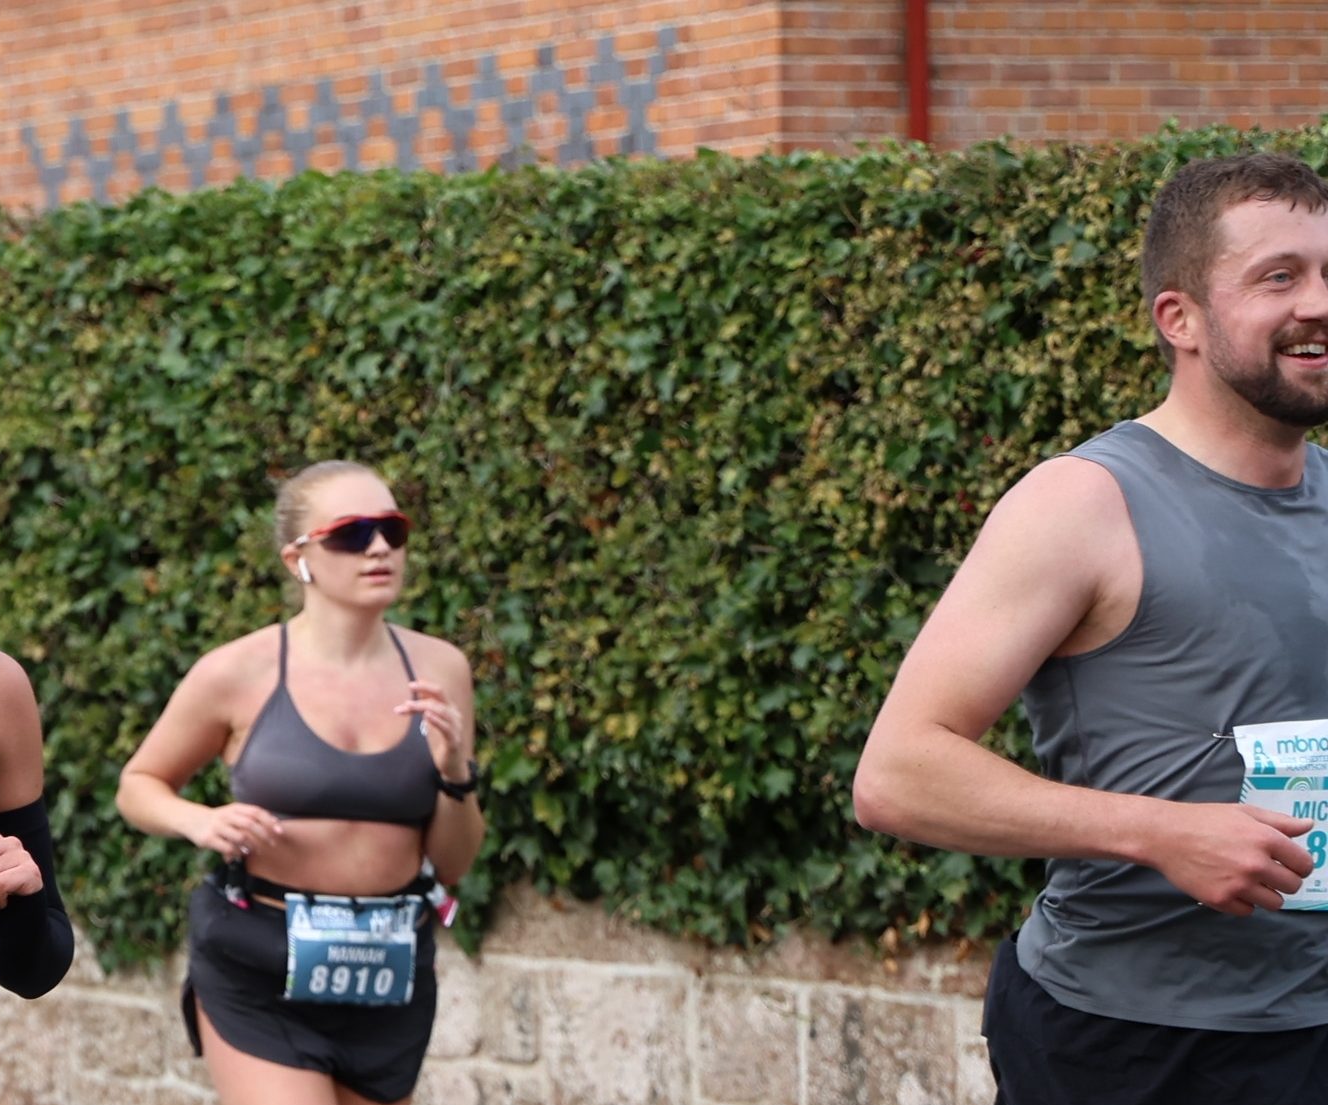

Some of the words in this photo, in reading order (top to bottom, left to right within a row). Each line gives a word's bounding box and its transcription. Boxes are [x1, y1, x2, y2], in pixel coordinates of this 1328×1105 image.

[1276, 735, 1328, 754] mbna
[327, 944, 387, 965] HANNAH
[308, 964, 394, 997] 8910
